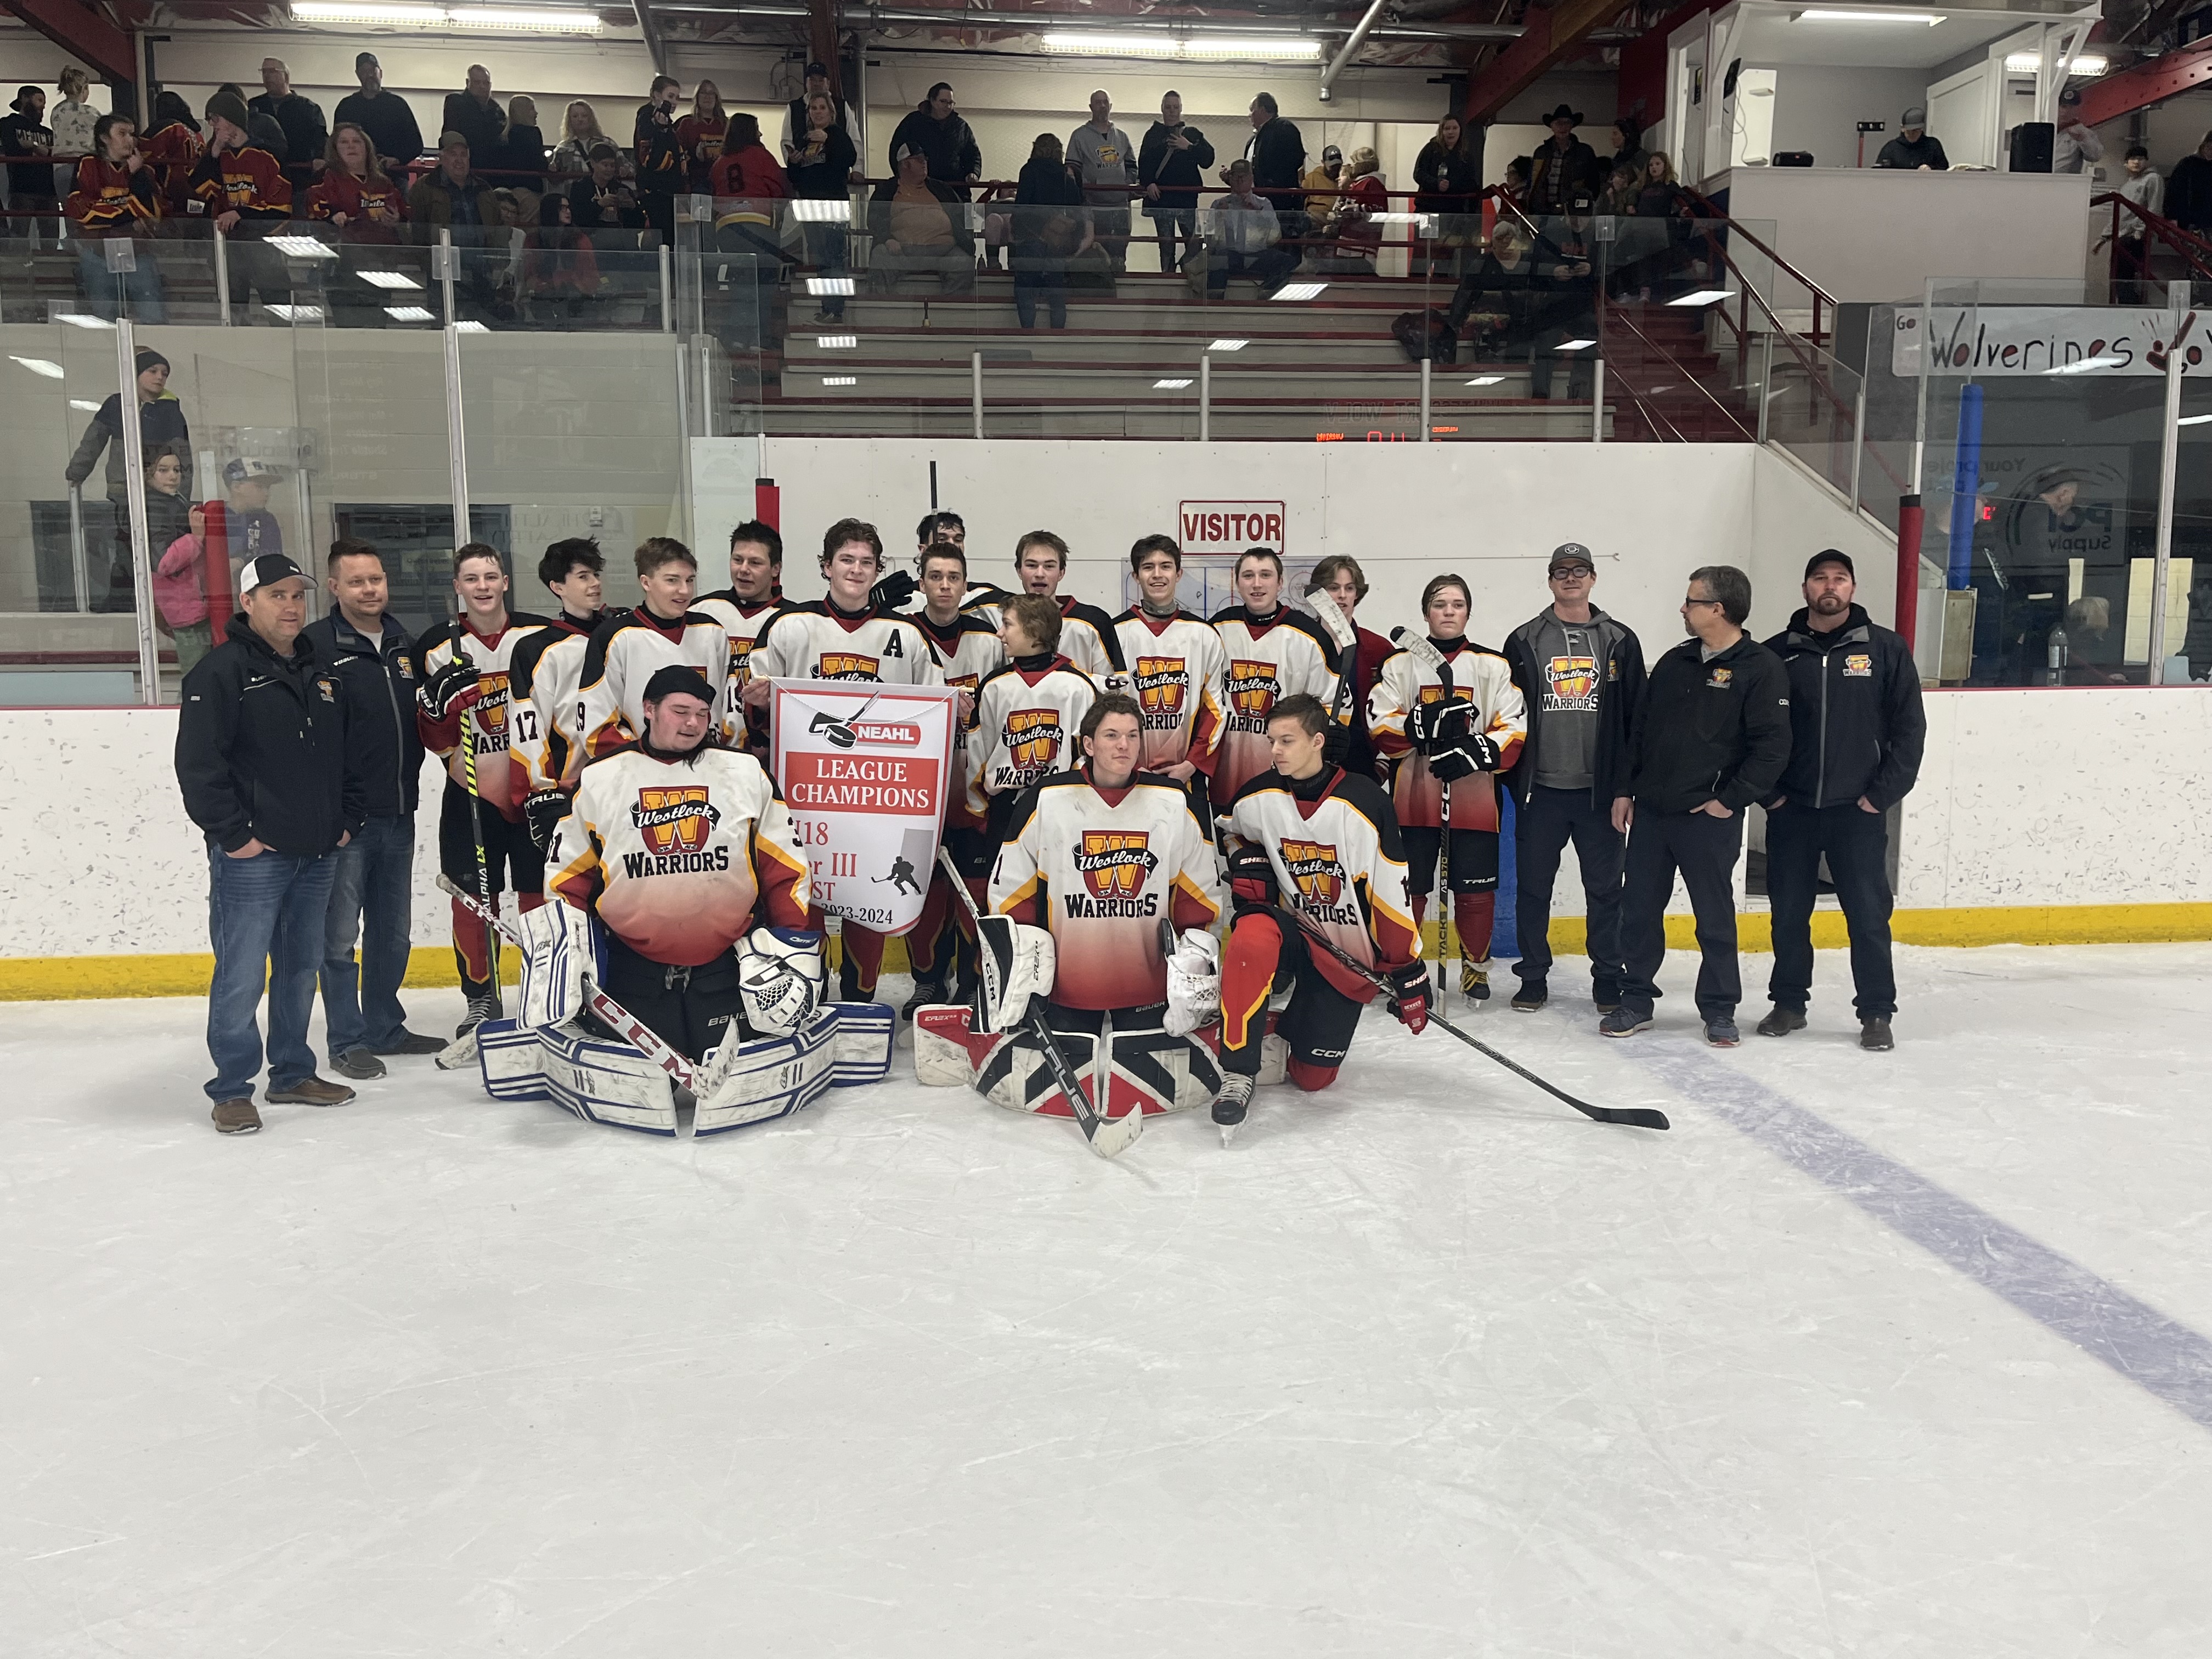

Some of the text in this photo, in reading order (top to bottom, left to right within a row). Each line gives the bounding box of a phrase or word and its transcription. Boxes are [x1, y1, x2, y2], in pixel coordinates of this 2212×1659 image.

[1182, 513, 1280, 541] VISITOR
[883, 629, 904, 658] A
[1228, 678, 1278, 695] Wetlock
[1542, 693, 1599, 712] WARRIORS
[516, 710, 539, 743] 17
[857, 725, 915, 741] NEAHL
[1006, 725, 1062, 747] Westlock
[816, 759, 907, 782] LEAGUE
[792, 783, 929, 809] CHAMPIONS
[637, 804, 714, 828] Westlock
[622, 845, 729, 879] WARRIORS
[831, 852, 857, 877] III
[1079, 850, 1152, 871] Westlock
[1463, 876, 1496, 884] TRUE
[1064, 893, 1159, 919] WARRIORS
[985, 962, 996, 1001] CCM
[592, 994, 692, 1090] CCM
[1311, 1048, 1346, 1058] CCM
[1034, 1018, 1091, 1122] TRUE
